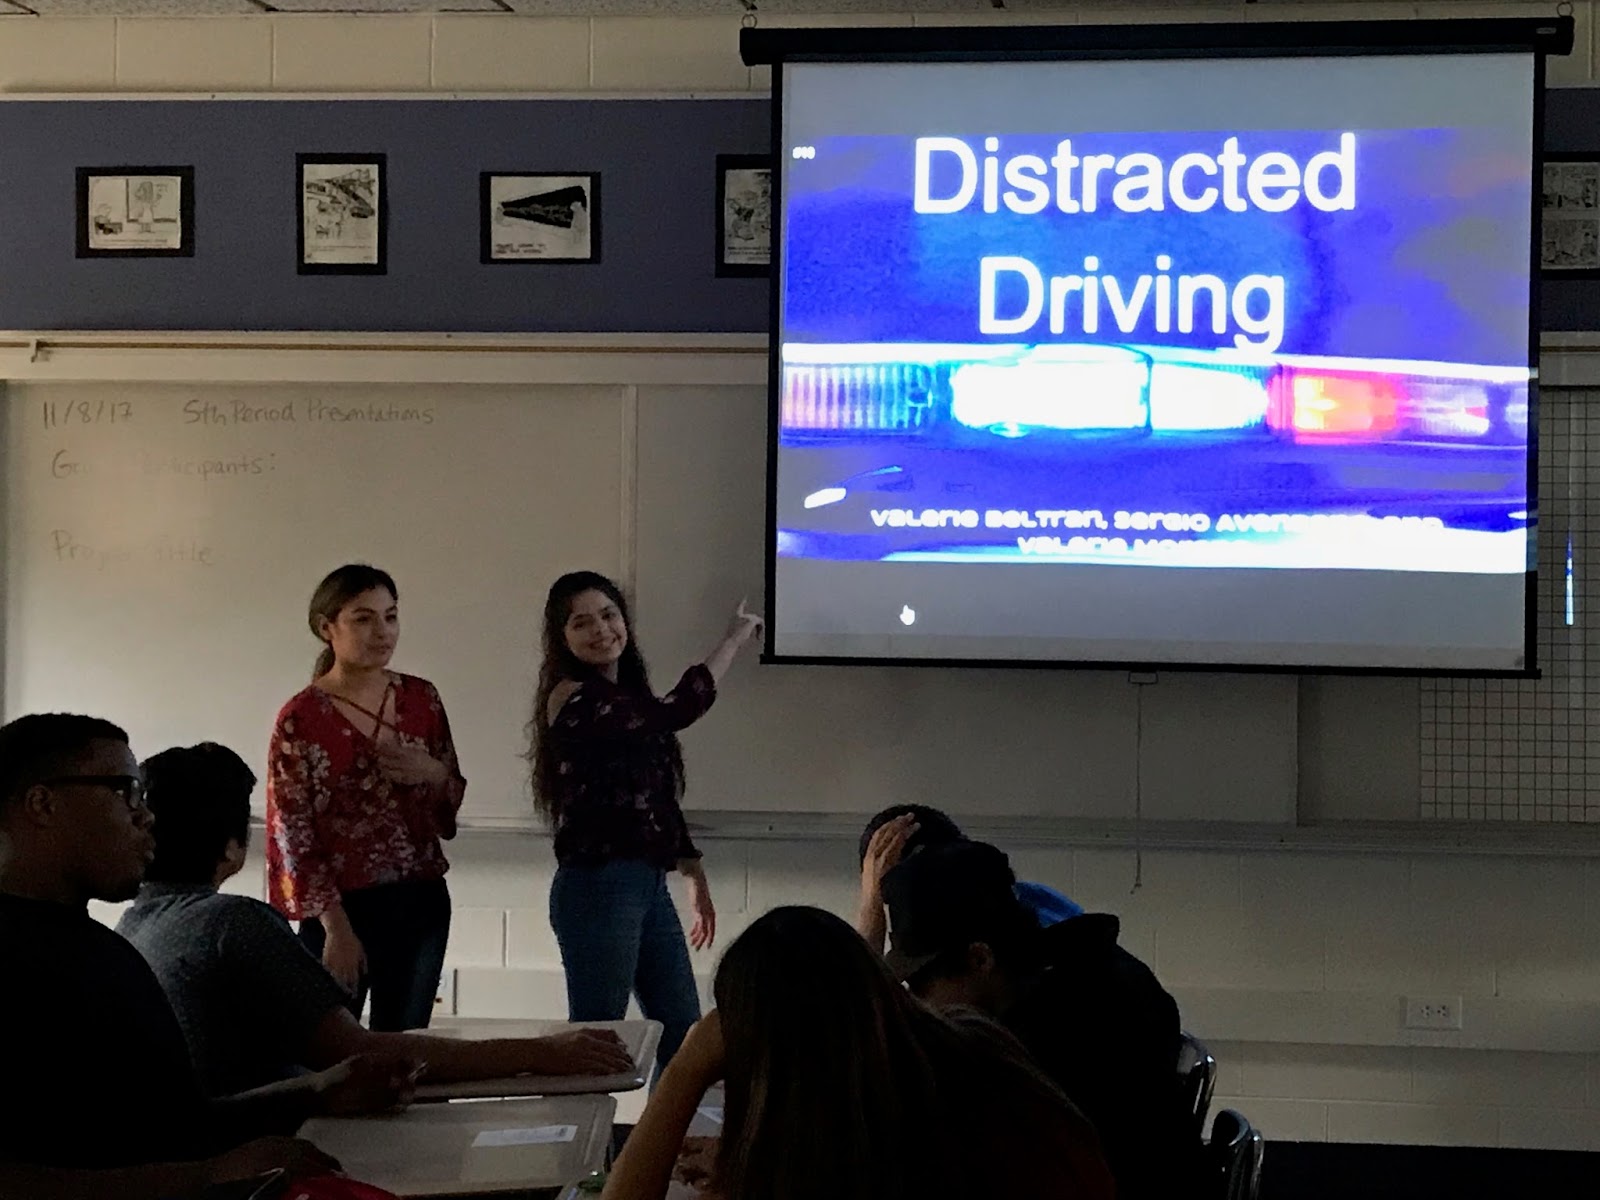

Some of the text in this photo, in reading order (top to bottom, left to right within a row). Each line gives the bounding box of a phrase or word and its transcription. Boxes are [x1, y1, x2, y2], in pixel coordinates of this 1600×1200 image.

[913, 132, 1356, 215] Distracted
[979, 255, 1286, 354] Driving
[42, 400, 133, 430] 11/8/17
[230, 400, 295, 424] Period
[304, 398, 435, 425] Presentations
